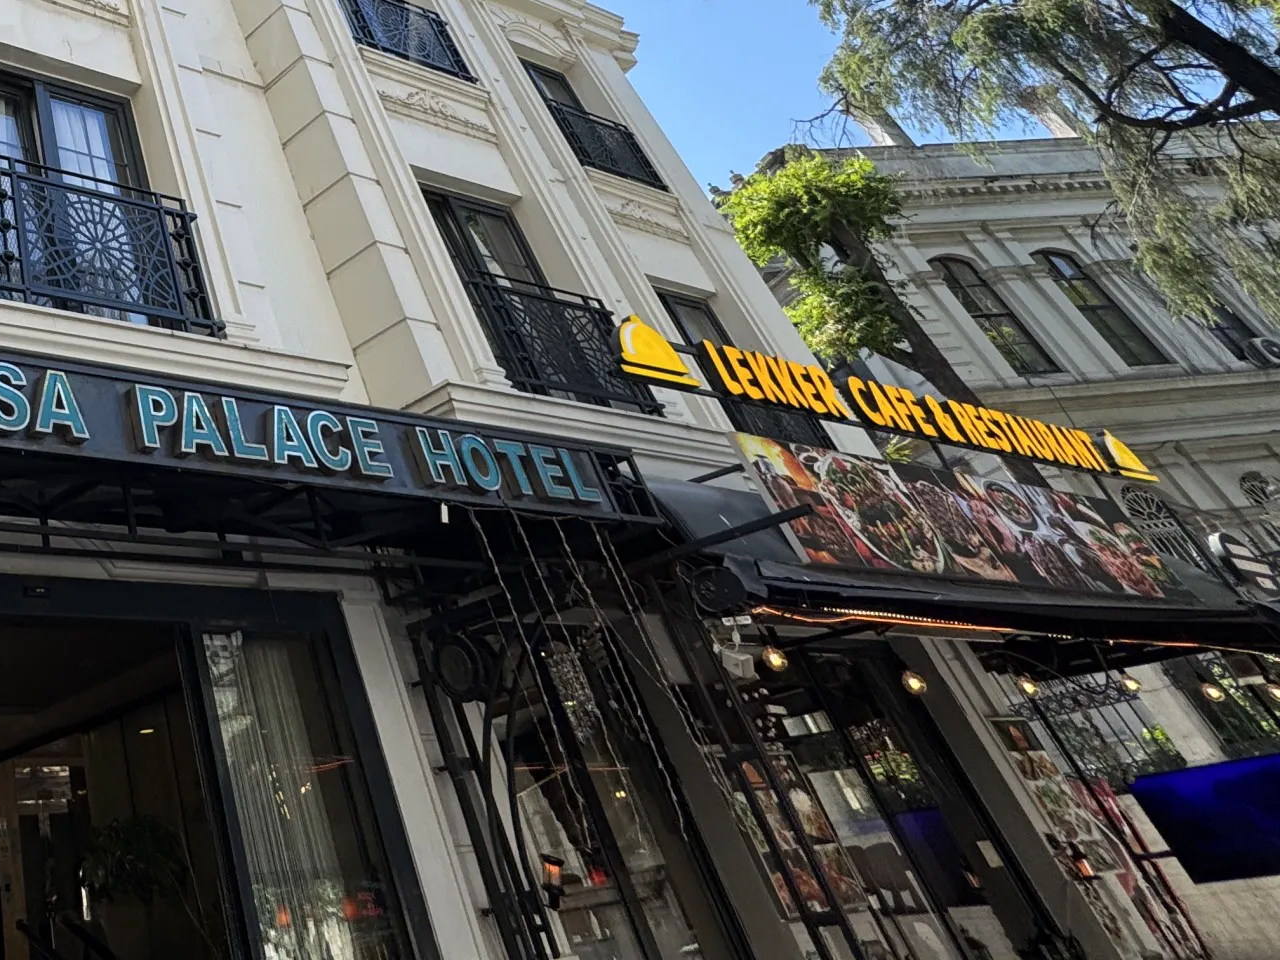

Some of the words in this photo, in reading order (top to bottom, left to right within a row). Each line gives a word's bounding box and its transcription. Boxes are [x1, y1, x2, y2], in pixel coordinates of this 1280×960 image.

[133, 383, 395, 479] PALACE
[415, 426, 602, 503] HOTEL
[703, 338, 850, 418] LEKKER
[847, 375, 938, 438] CAFE
[926, 393, 960, 443] &
[947, 399, 1111, 473] RESTAURANT
